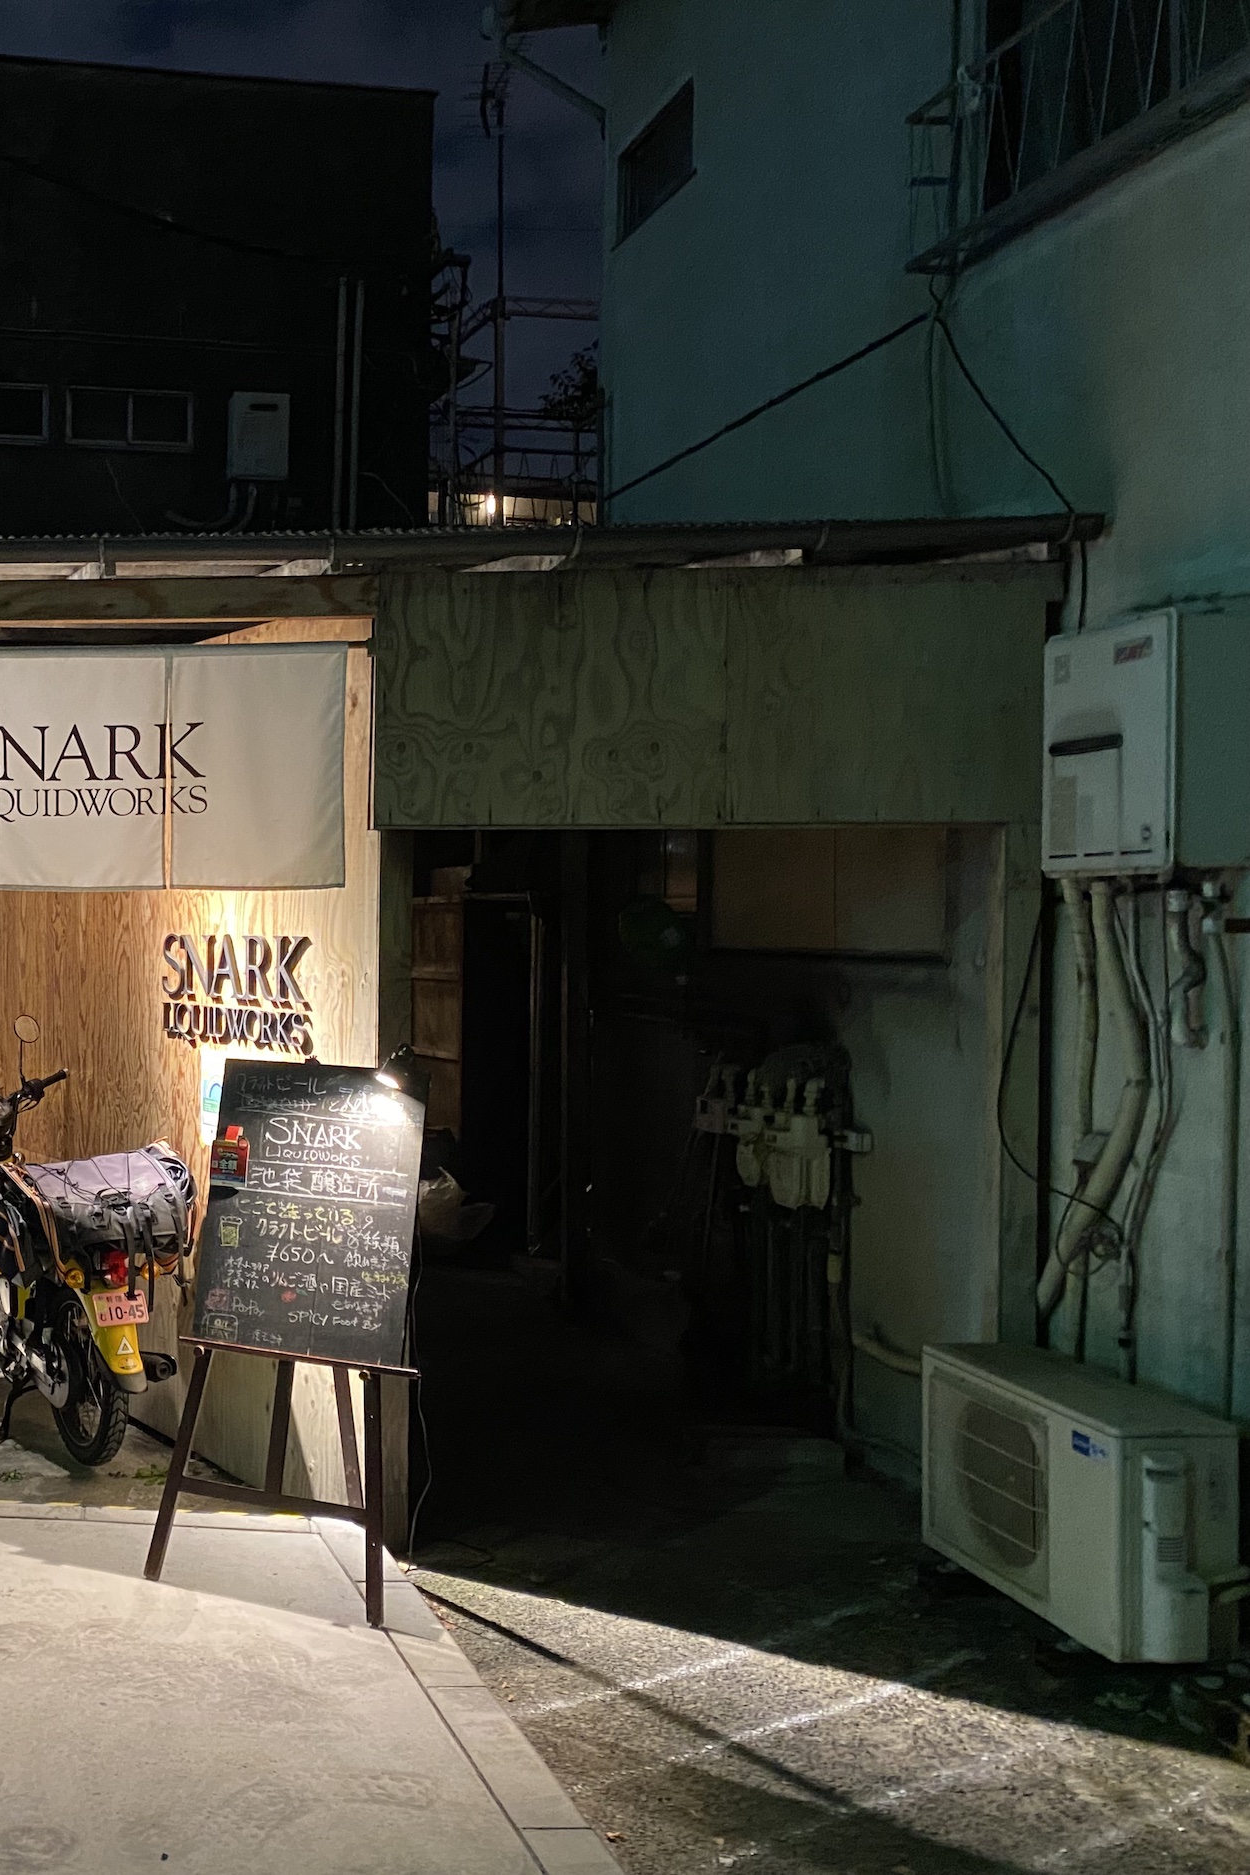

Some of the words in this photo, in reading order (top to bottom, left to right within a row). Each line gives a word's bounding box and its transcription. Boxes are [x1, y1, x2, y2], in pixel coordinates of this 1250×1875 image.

[161, 933, 312, 1008] SNARK
[162, 1002, 313, 1054] LIQUIDWORKS
[264, 1116, 363, 1150] SNARK
